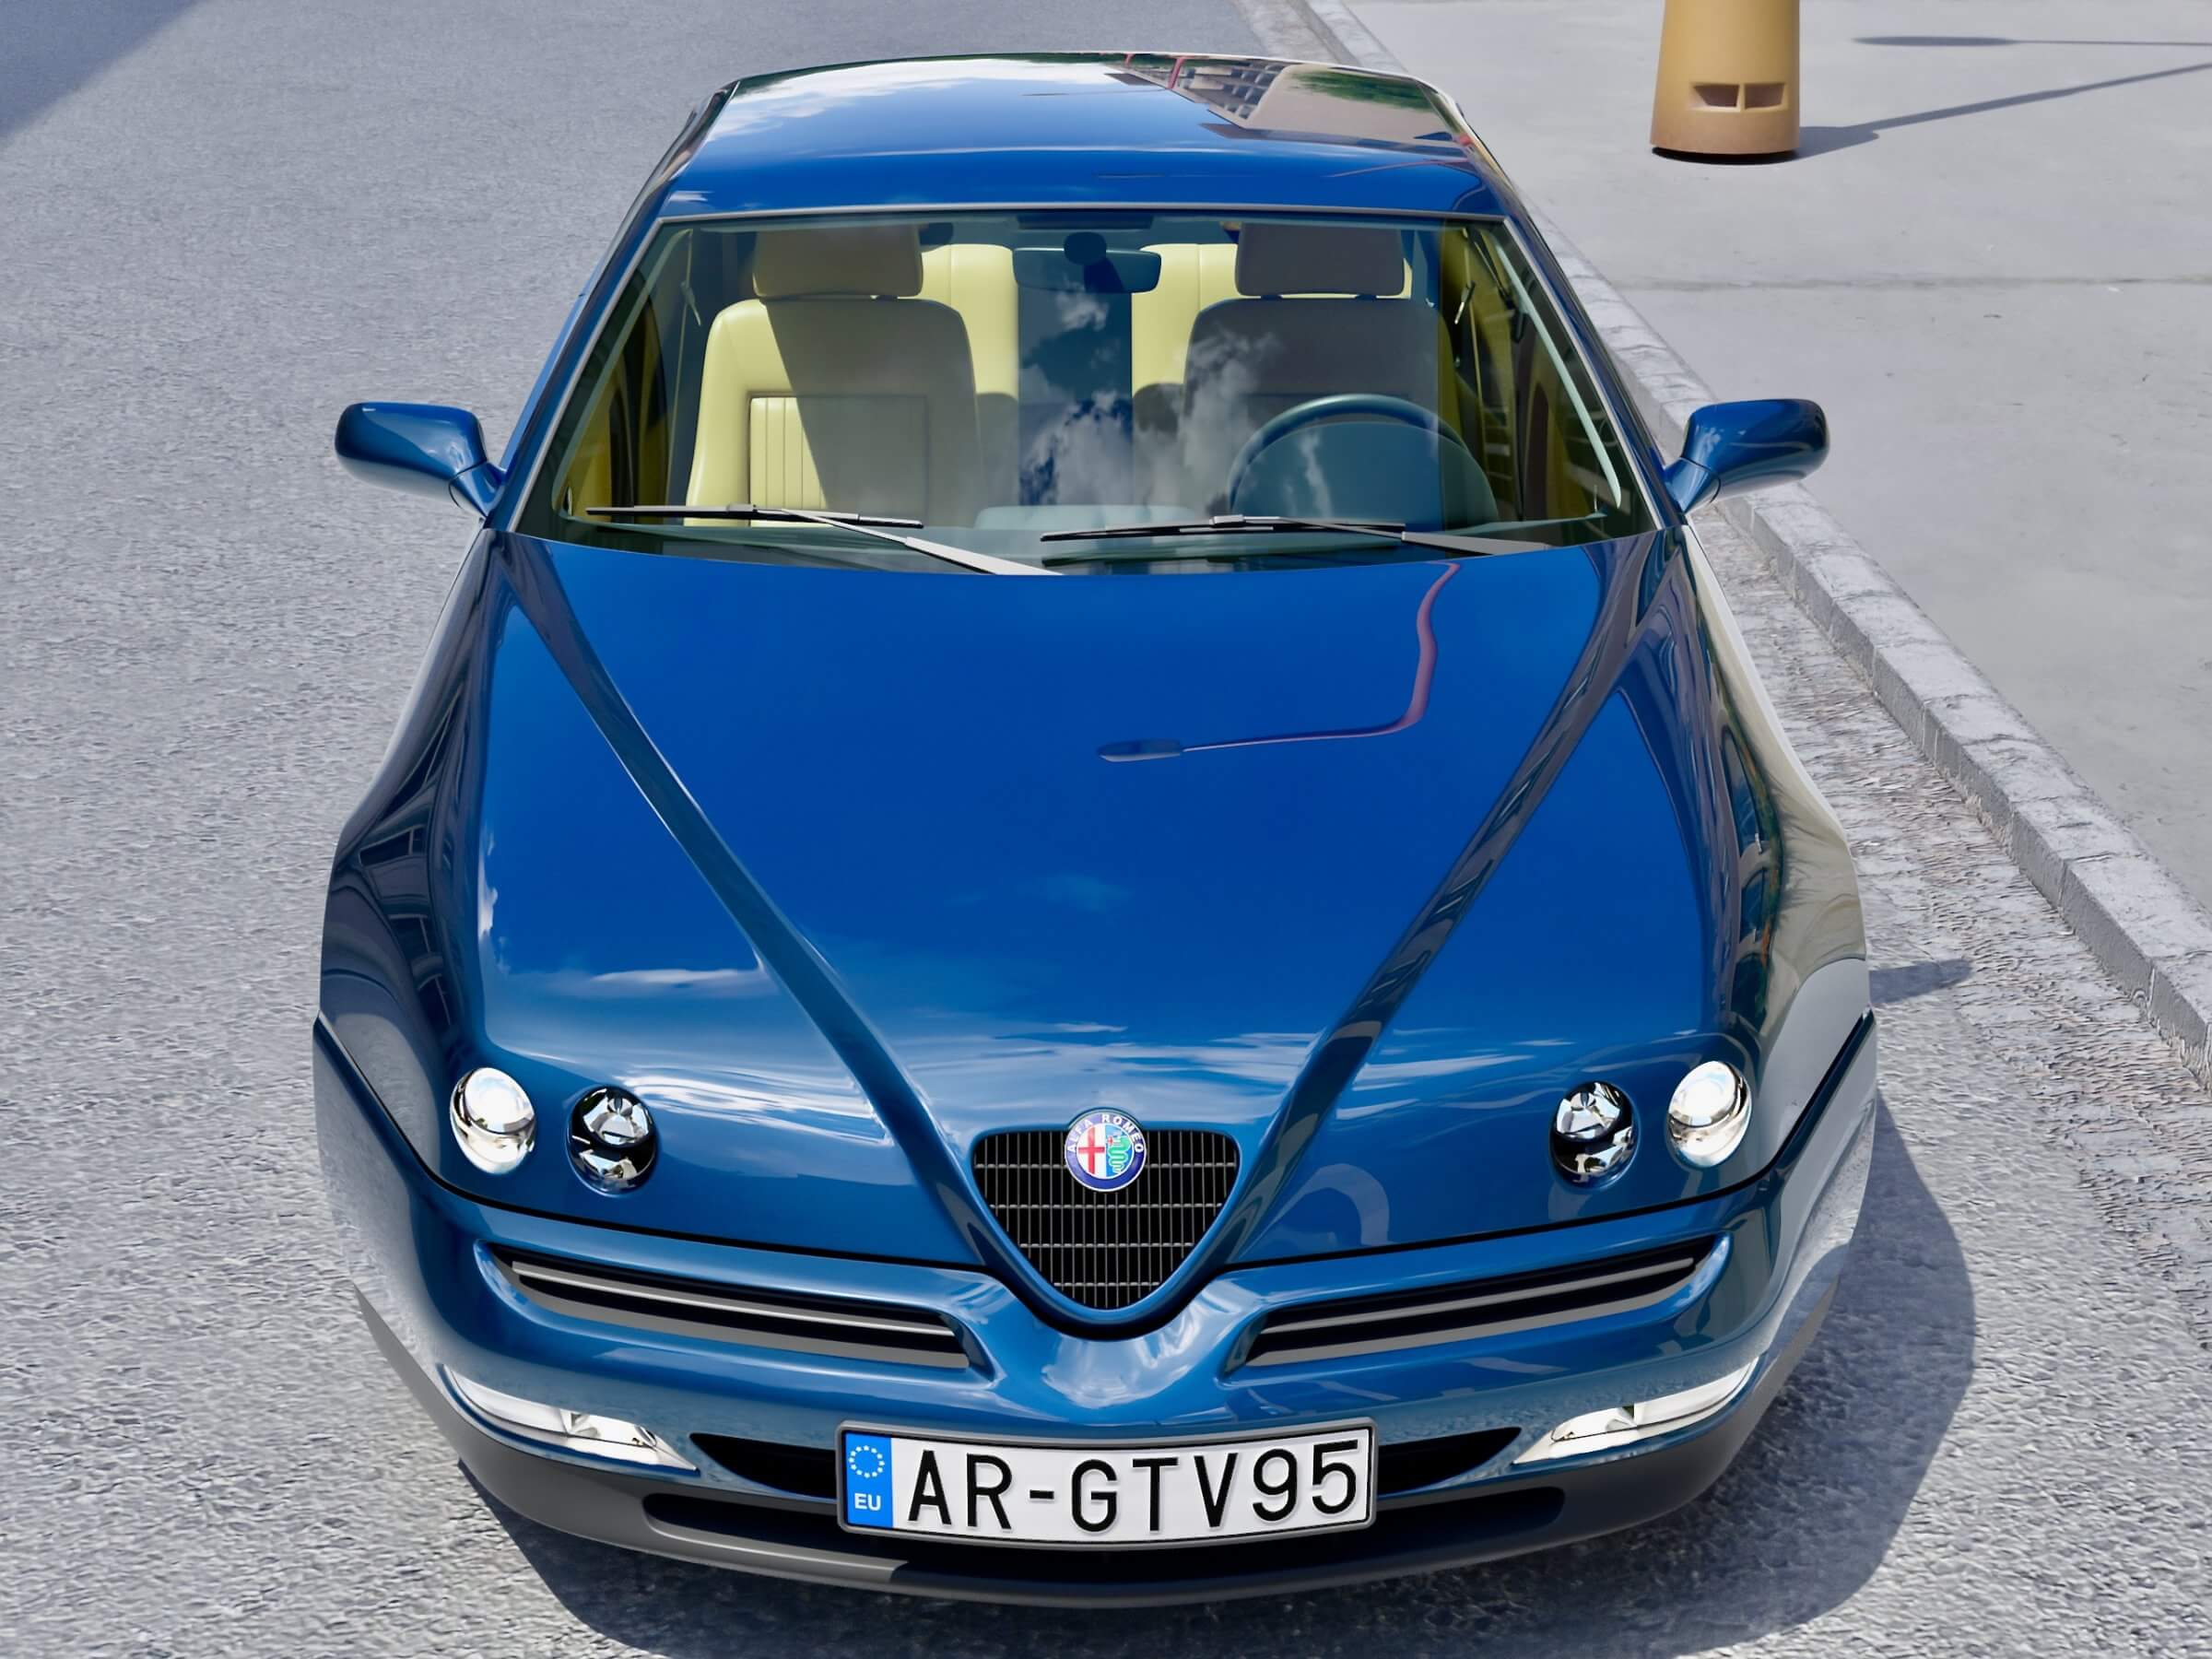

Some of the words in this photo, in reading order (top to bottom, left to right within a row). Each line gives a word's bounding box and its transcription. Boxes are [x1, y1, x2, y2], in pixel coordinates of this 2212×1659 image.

[1066, 1118, 1094, 1153] ALFA
[1101, 1113, 1145, 1153] ROMEO
[854, 1492, 882, 1512] EU
[908, 1439, 1359, 1533] AR-GTV95
